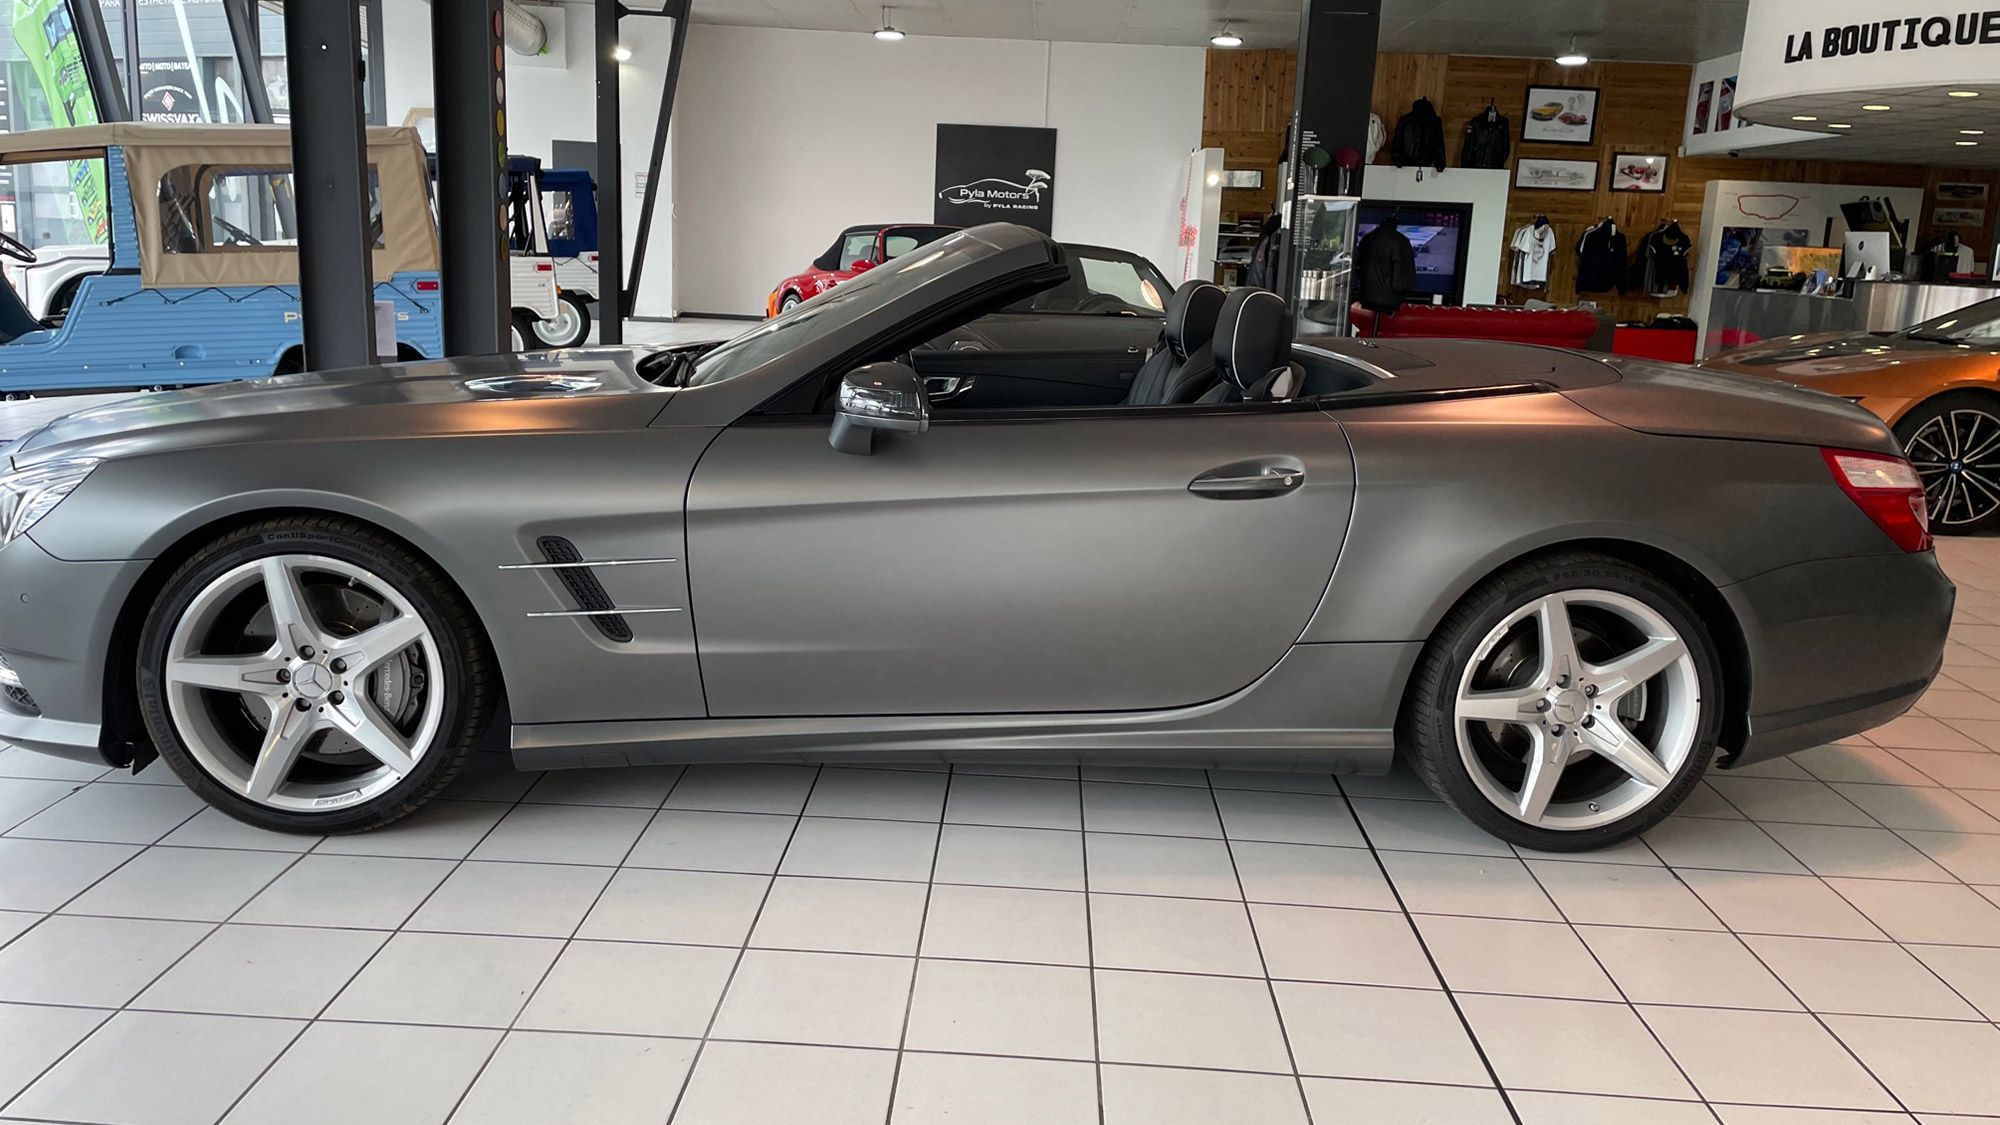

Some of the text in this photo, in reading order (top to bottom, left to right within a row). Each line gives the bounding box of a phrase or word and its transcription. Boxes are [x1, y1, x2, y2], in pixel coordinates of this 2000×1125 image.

[1784, 10, 2000, 64] LA BOUTIQUE
[960, 188, 1030, 200] Pyla Motors
